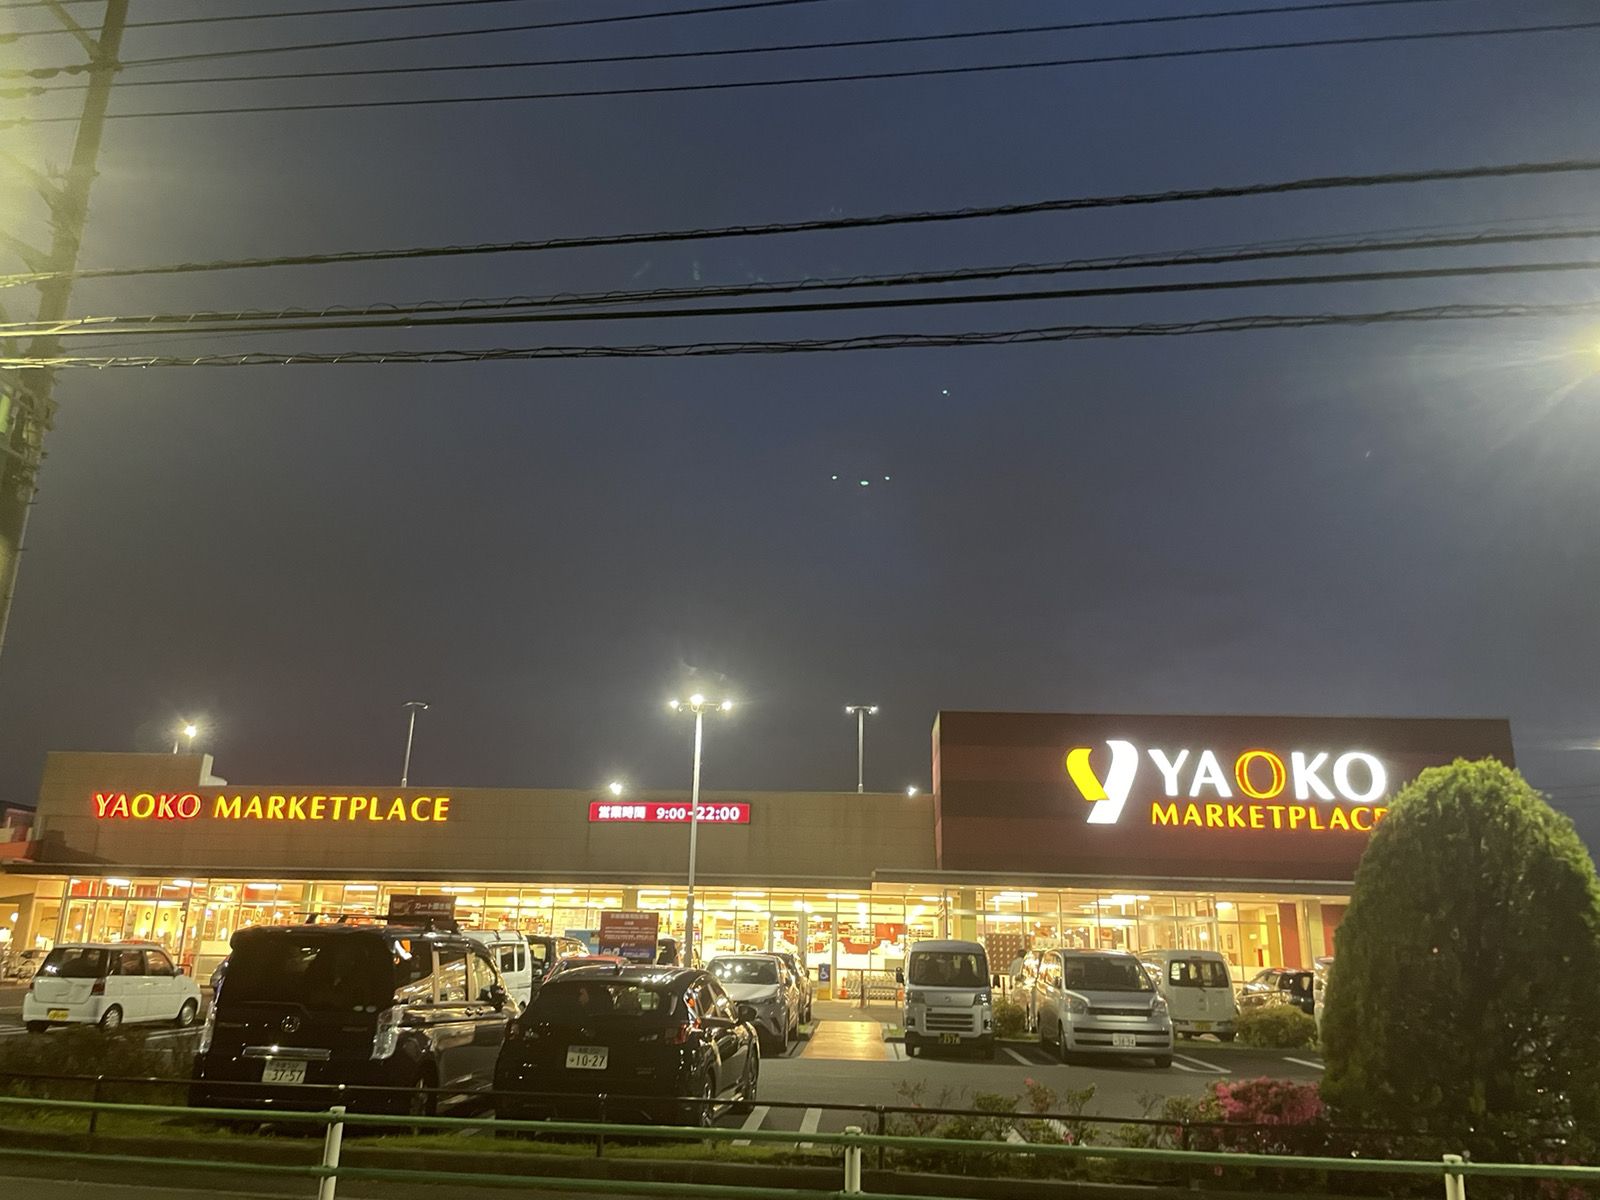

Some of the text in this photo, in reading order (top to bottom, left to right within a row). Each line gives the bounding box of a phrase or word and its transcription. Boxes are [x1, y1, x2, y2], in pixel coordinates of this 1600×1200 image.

[1147, 749, 1387, 802] YAOKO
[95, 793, 450, 821] YAOKO MARKETPLACE
[598, 805, 647, 819] 営業時間
